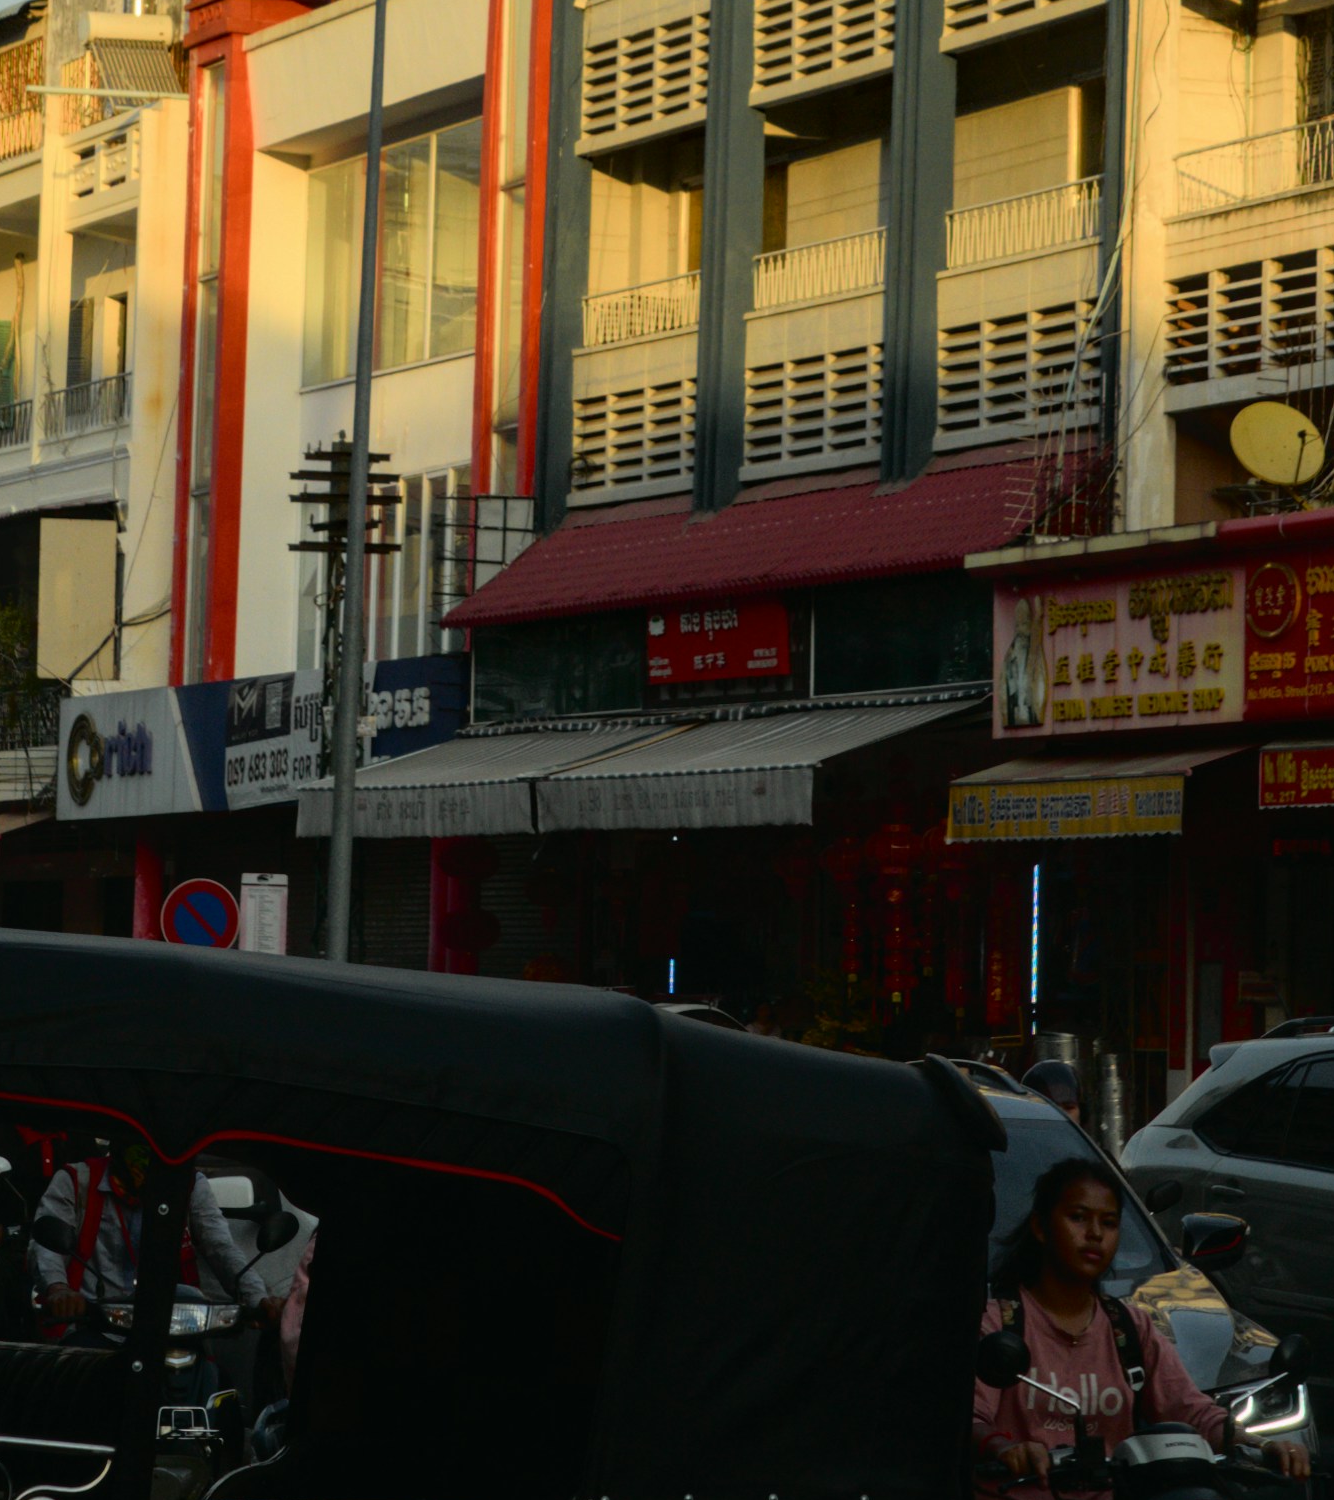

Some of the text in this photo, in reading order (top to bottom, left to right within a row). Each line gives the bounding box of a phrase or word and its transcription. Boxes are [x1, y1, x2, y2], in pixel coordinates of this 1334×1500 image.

[248, 752, 267, 784] 683
[270, 748, 289, 779] 303
[293, 754, 312, 780] FOR
[1027, 1367, 1124, 1416] Hello
